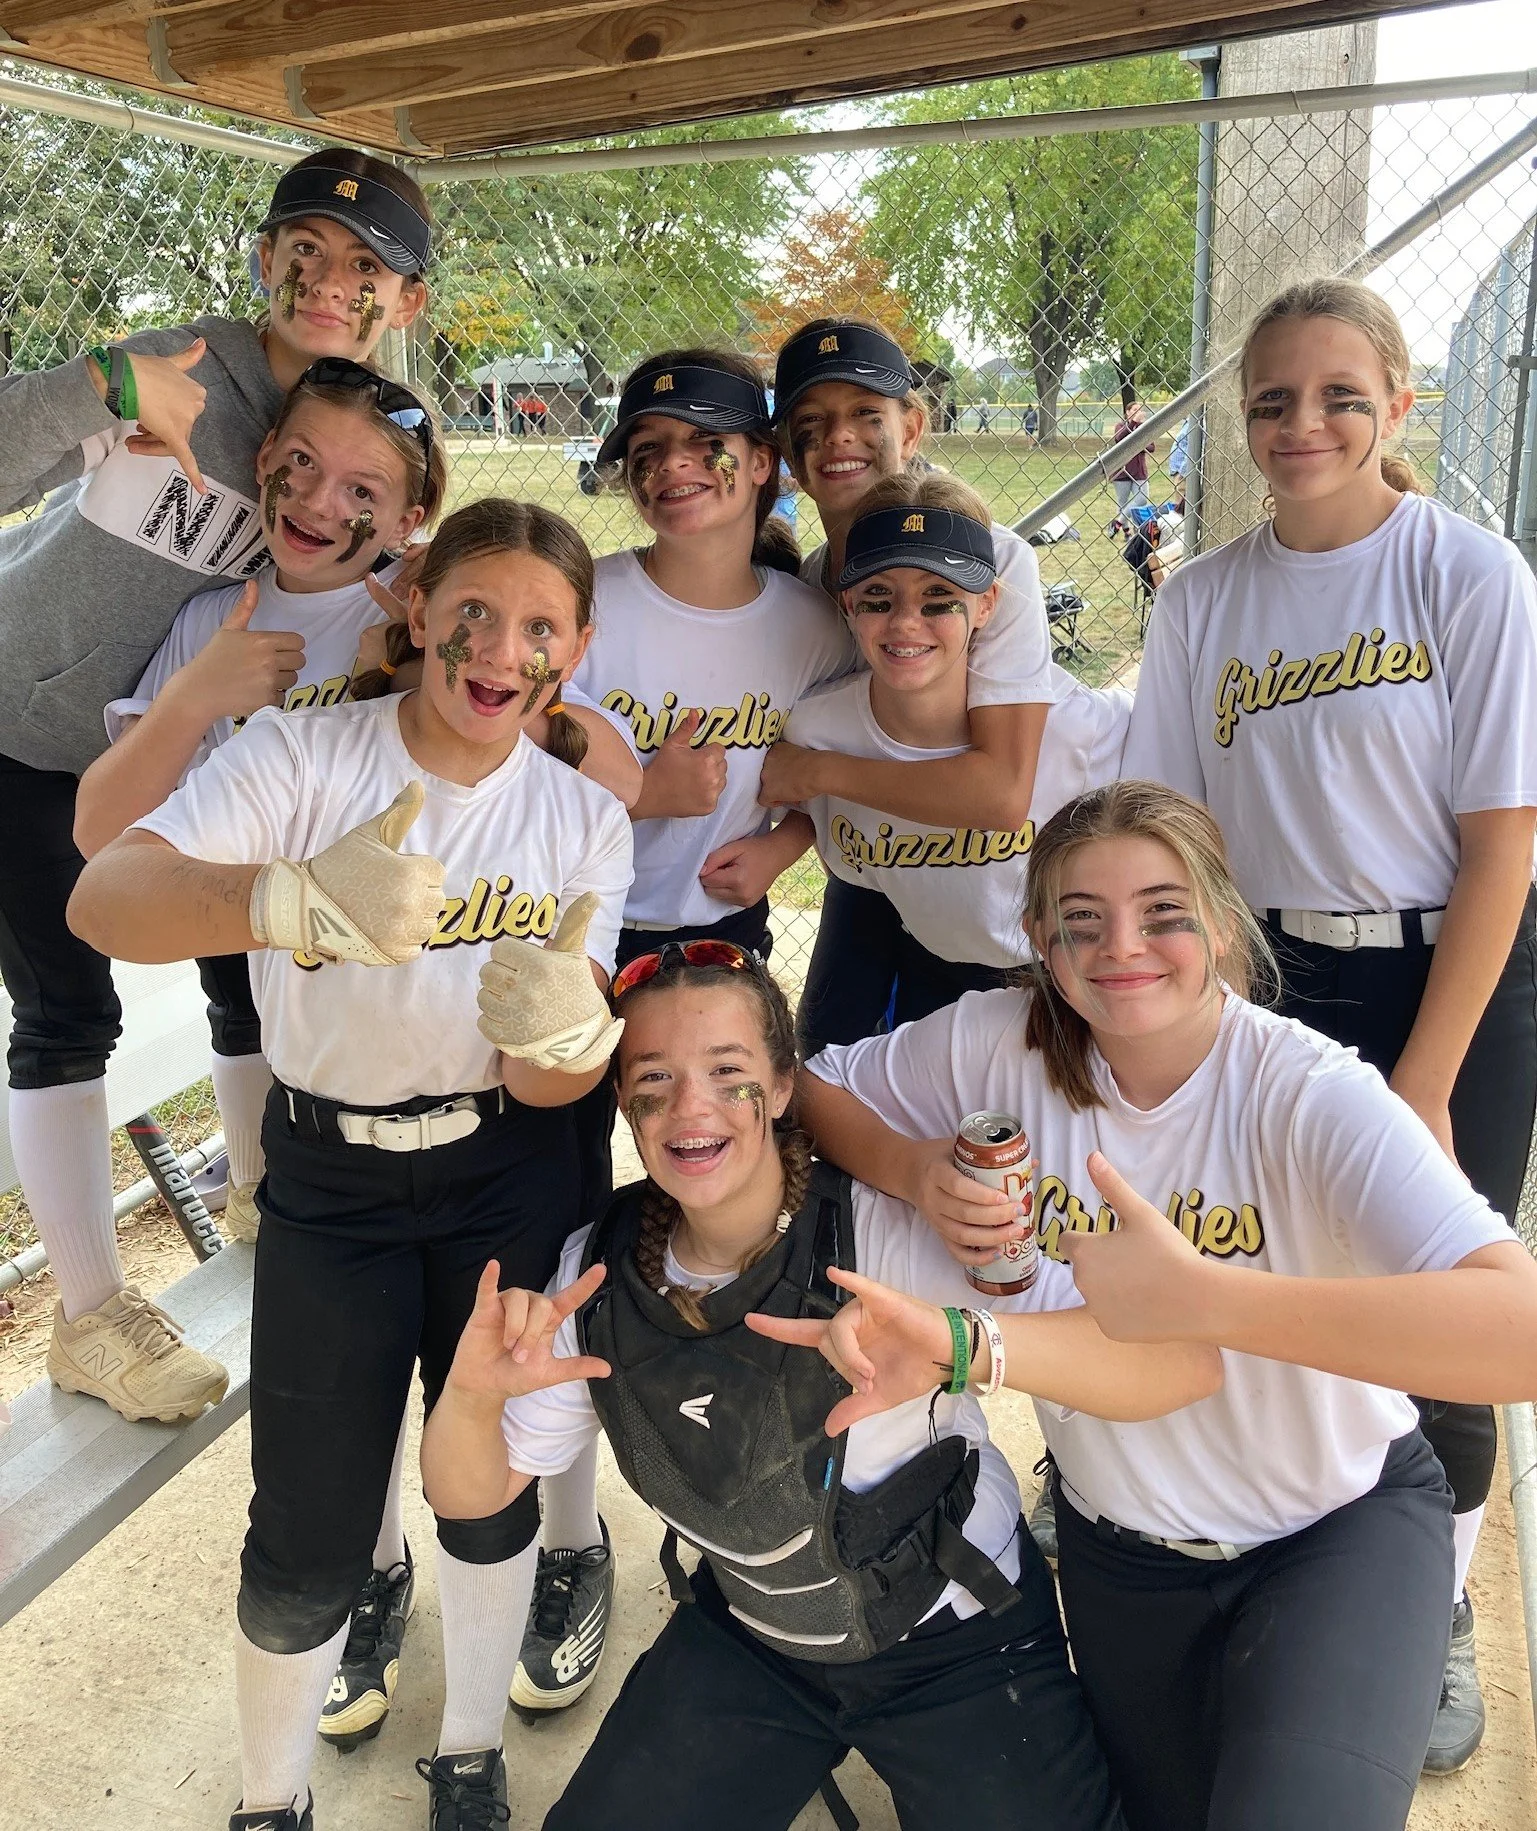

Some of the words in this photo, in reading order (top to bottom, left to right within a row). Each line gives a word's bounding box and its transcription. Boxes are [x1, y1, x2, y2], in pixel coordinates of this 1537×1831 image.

[1213, 627, 1433, 748] Grizzlies
[831, 814, 1036, 874] Grizzlies
[422, 874, 559, 951] zlies
[994, 1150, 1018, 1163] SUPER
[1034, 1174, 1264, 1264] Grilies
[953, 1321, 967, 1379] INTENTIONAL
